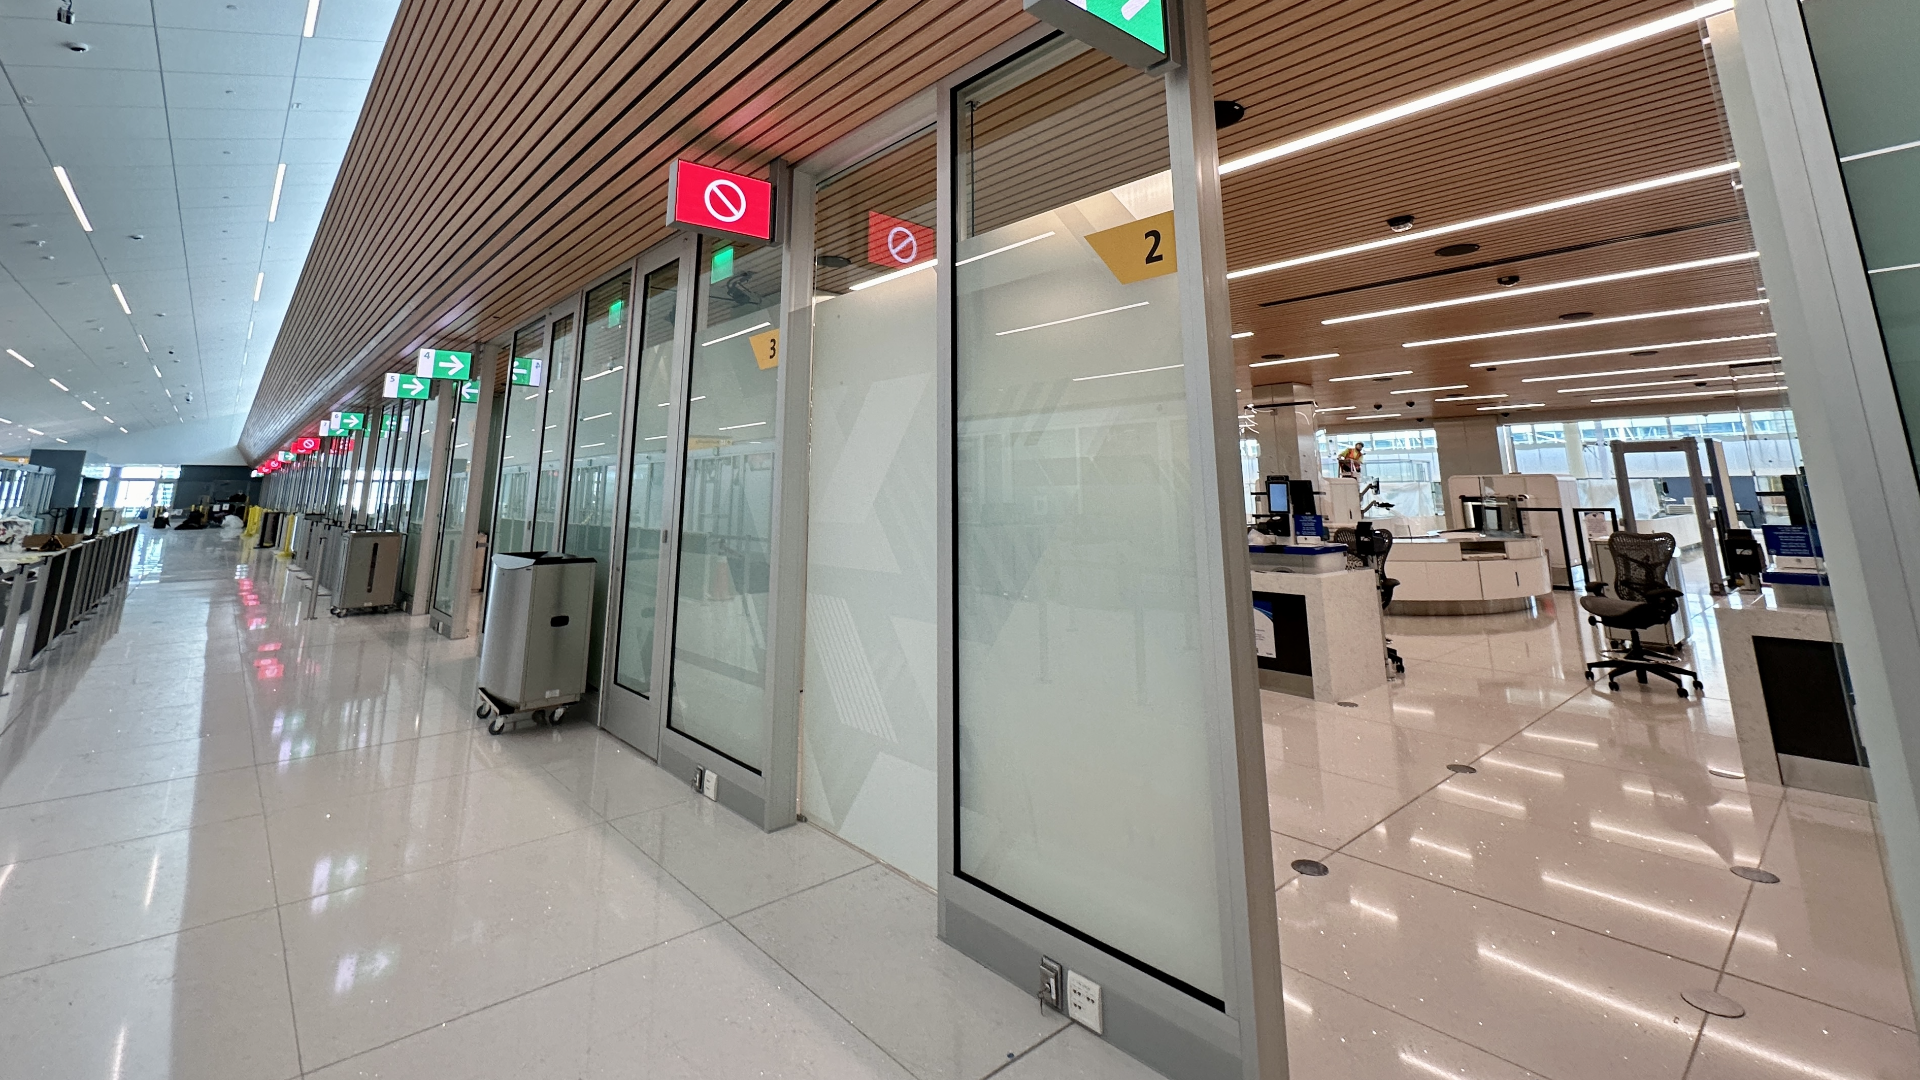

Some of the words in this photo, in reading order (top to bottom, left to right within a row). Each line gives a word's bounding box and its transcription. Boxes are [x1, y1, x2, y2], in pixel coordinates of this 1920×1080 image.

[1144, 229, 1163, 265] 2
[423, 351, 431, 360] 4
[769, 338, 777, 360] 3
[389, 375, 396, 383] 5
